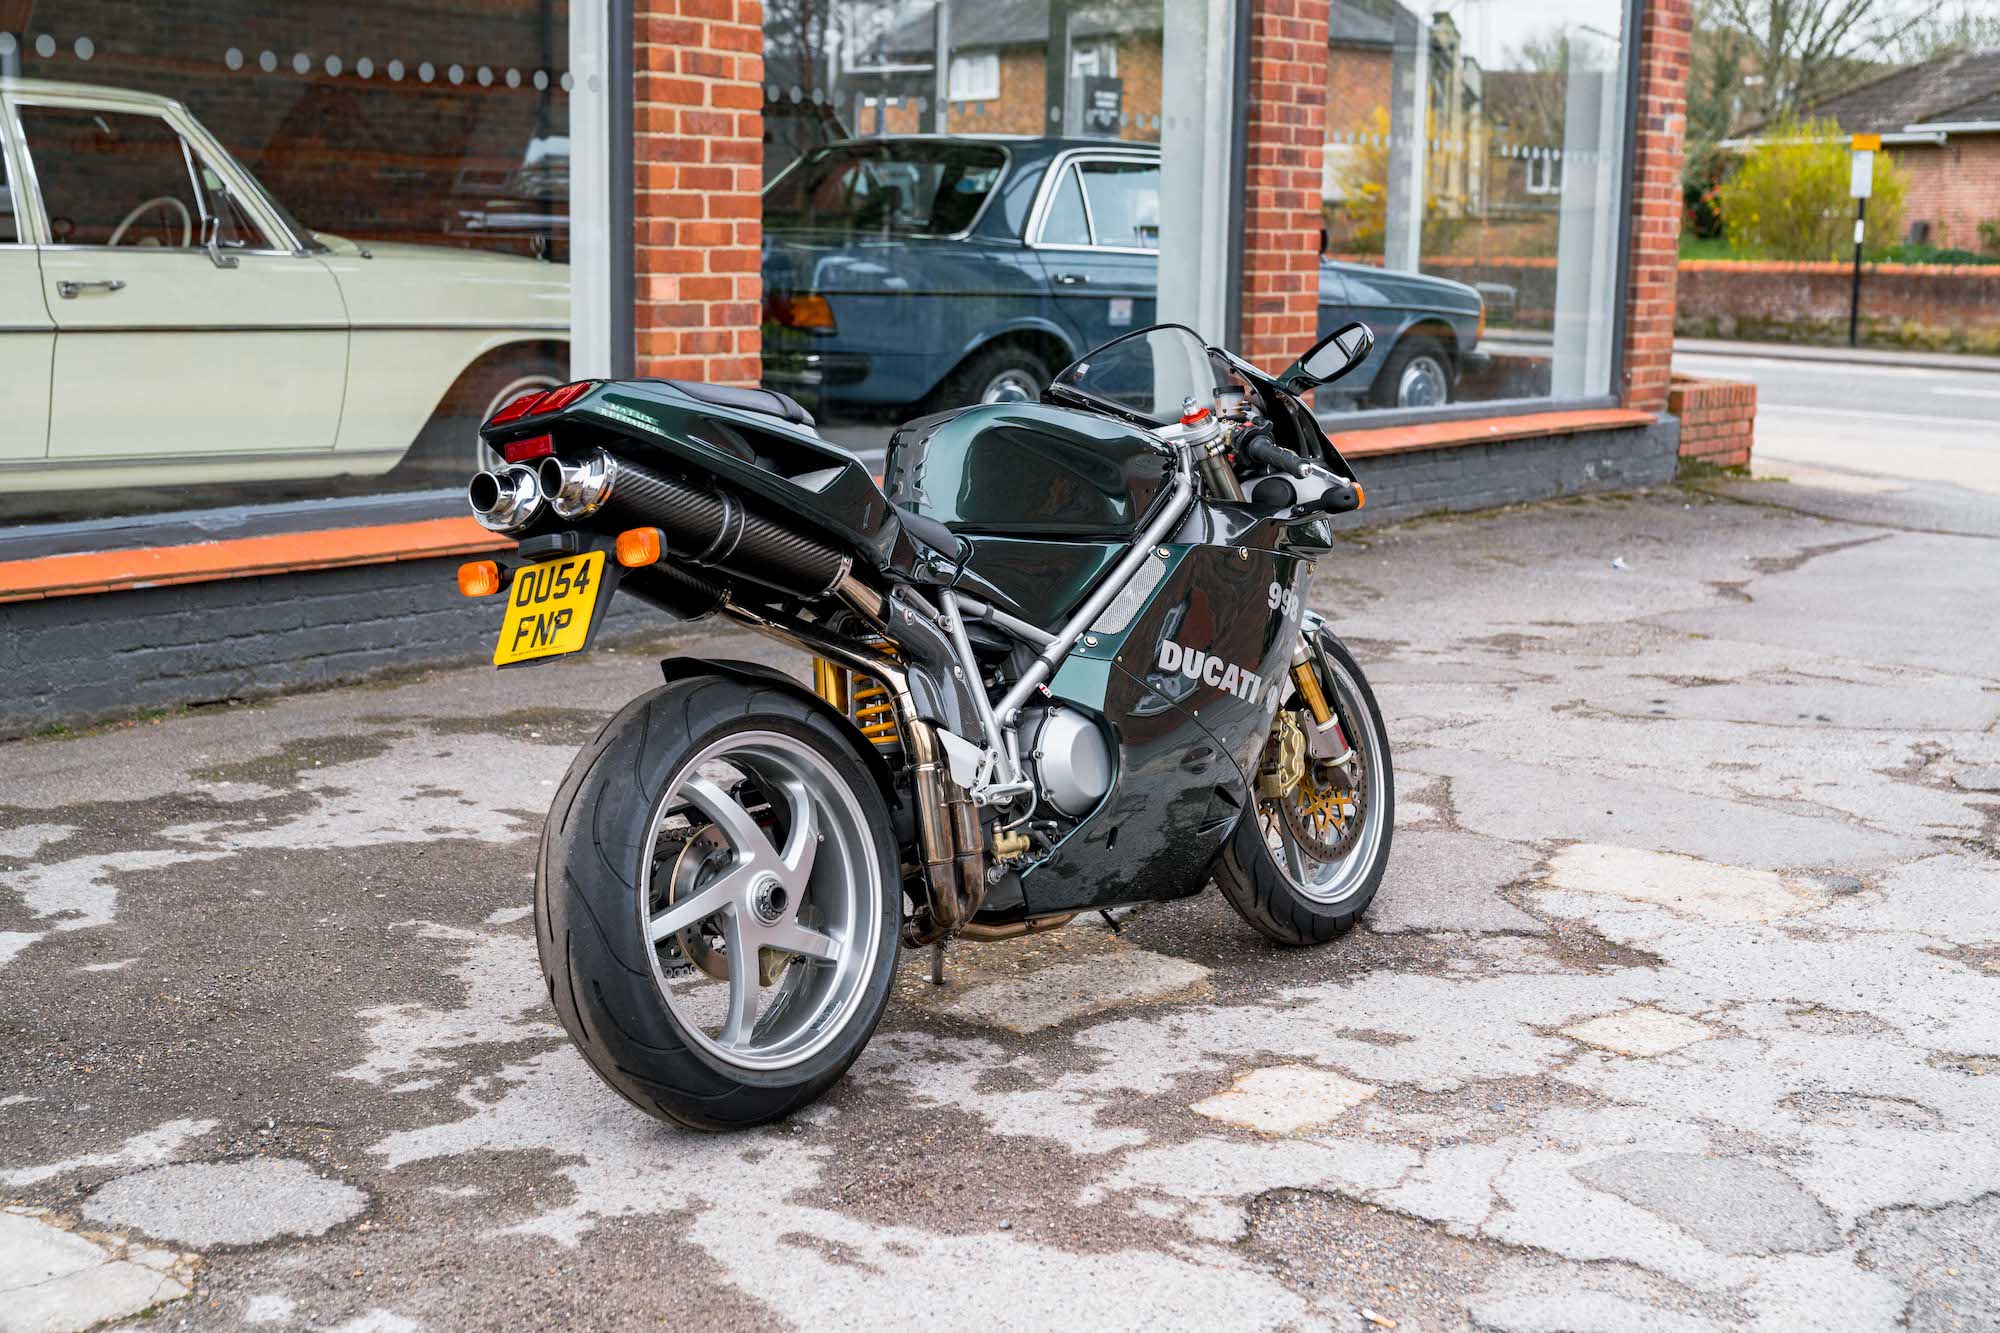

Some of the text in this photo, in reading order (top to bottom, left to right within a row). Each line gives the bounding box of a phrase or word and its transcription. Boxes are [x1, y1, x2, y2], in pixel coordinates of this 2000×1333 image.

[599, 408, 660, 434] RELOADED
[609, 402, 653, 424] MATRIX
[515, 559, 591, 607] OU54
[1267, 582, 1299, 623] 998
[511, 608, 573, 652] FNP
[1158, 640, 1262, 704] DUCATI
